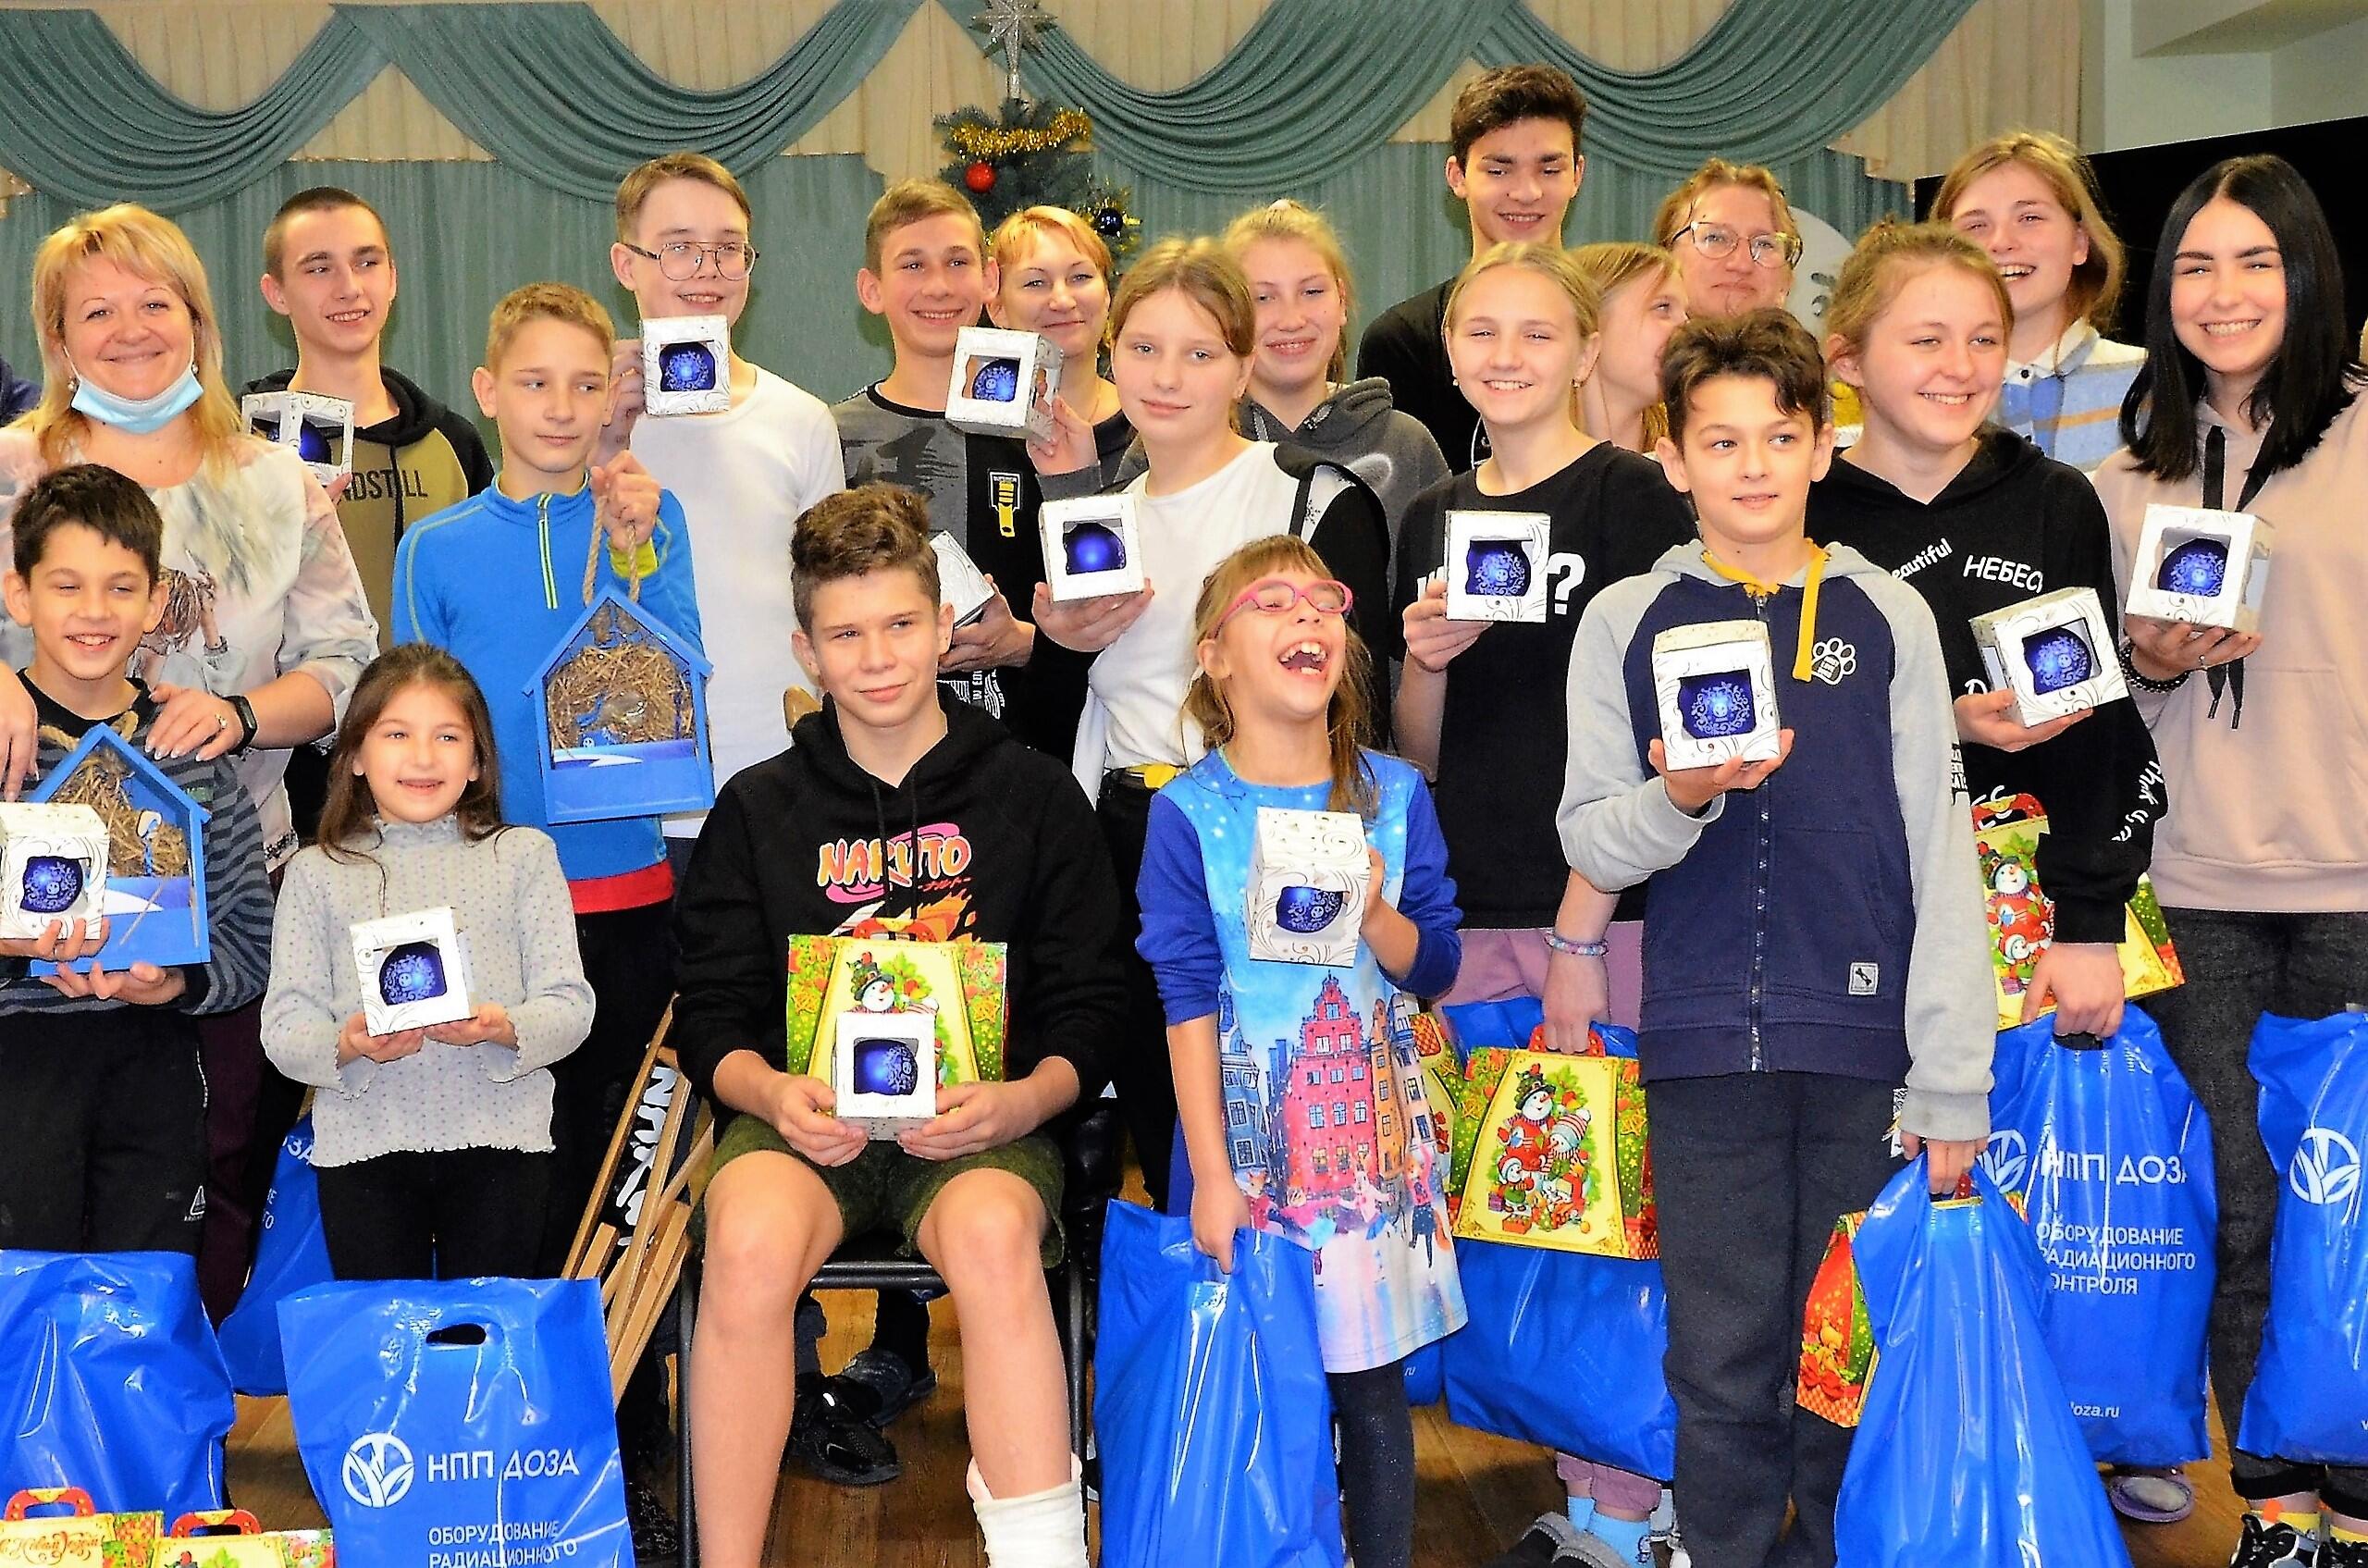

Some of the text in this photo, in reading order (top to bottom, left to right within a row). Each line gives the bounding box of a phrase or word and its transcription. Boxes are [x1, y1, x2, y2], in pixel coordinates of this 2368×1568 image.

[1891, 537, 1953, 580] eautiful
[817, 835, 972, 887] NARUTO
[2036, 1221, 2184, 1247] ОБОРУДОВАНИЕ
[2051, 1272, 2139, 1295] ОНТРОЛЯ
[2070, 1401, 2120, 1418] oza.ru
[427, 1448, 580, 1483] НПП ДОЗА
[428, 1520, 560, 1545] ОБОРУДОВАНИЕ
